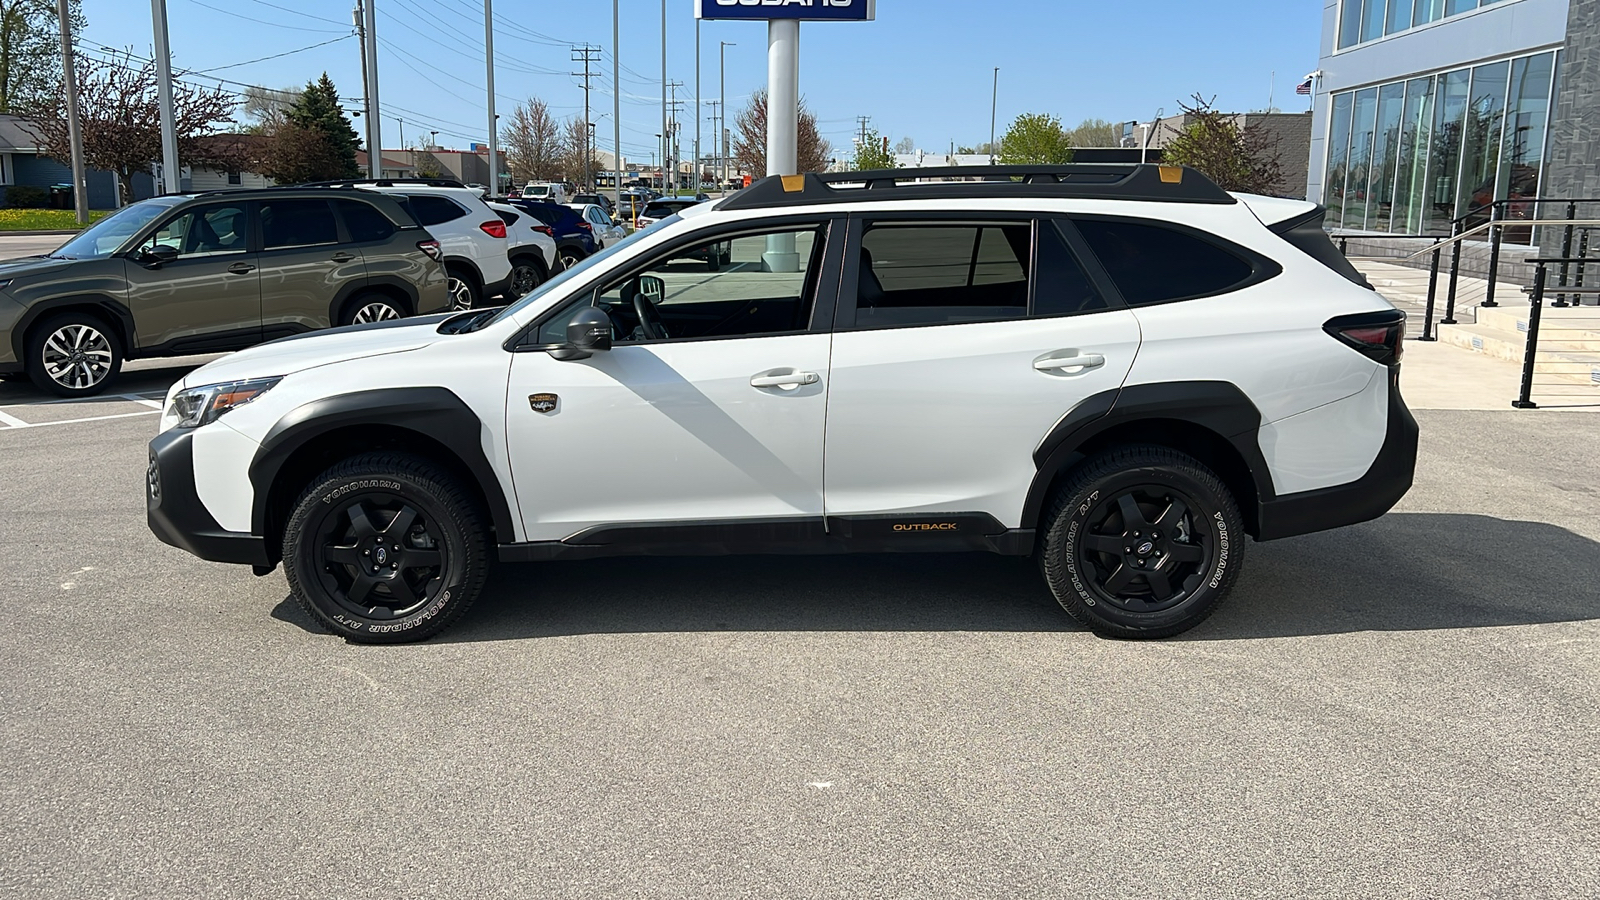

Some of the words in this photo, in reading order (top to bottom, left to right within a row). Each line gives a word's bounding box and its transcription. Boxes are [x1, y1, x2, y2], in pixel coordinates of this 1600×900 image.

[322, 480, 401, 504] YOKOHAMA
[1079, 490, 1099, 516] A/T
[893, 523, 957, 531] OUTBACK
[1209, 511, 1229, 589] YOKOHAMA
[1066, 520, 1096, 607] GEOLANDAR
[333, 614, 363, 630] A/T
[368, 590, 451, 633] GEOLANDAR
